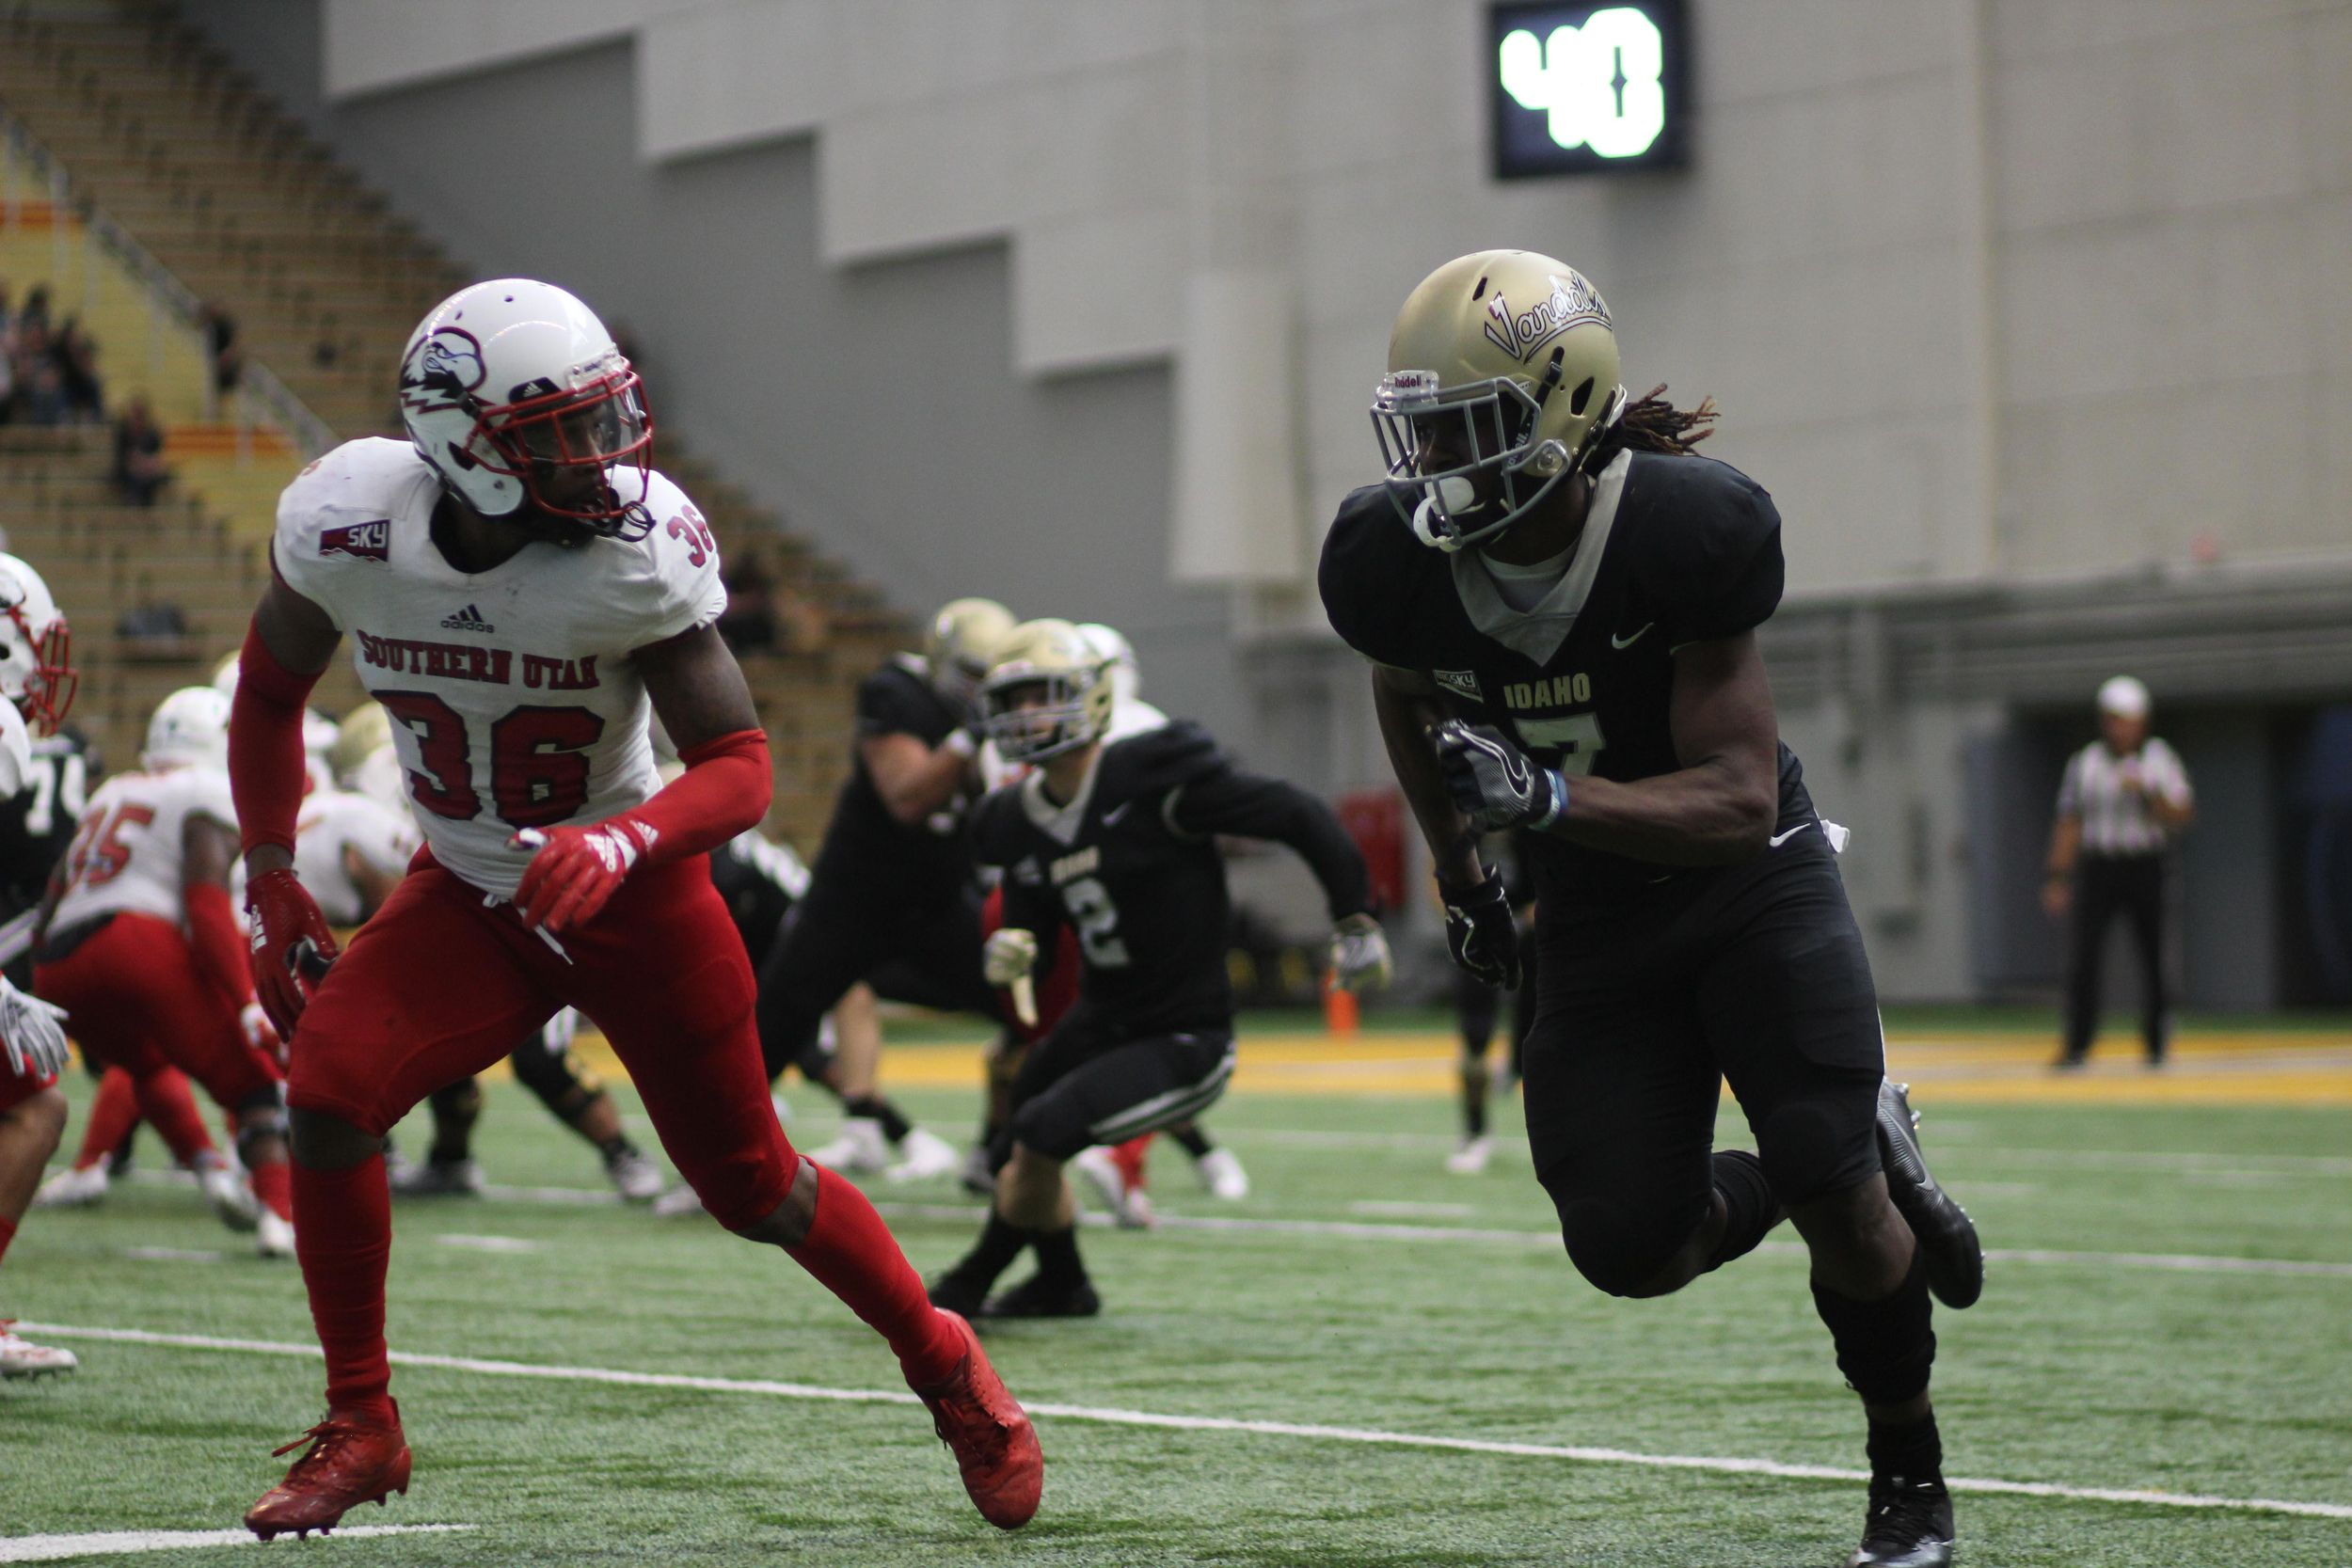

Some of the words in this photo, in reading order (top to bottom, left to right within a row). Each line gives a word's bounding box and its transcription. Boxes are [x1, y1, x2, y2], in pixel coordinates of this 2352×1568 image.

[347, 524, 387, 548] SKY
[666, 503, 714, 568] 36
[440, 620, 495, 634] adidas
[356, 629, 513, 685] SOUTHERN
[521, 653, 600, 690] UTAH
[1503, 673, 1592, 709] IDAHO
[371, 689, 605, 830] 36
[1064, 877, 1130, 967] 2
